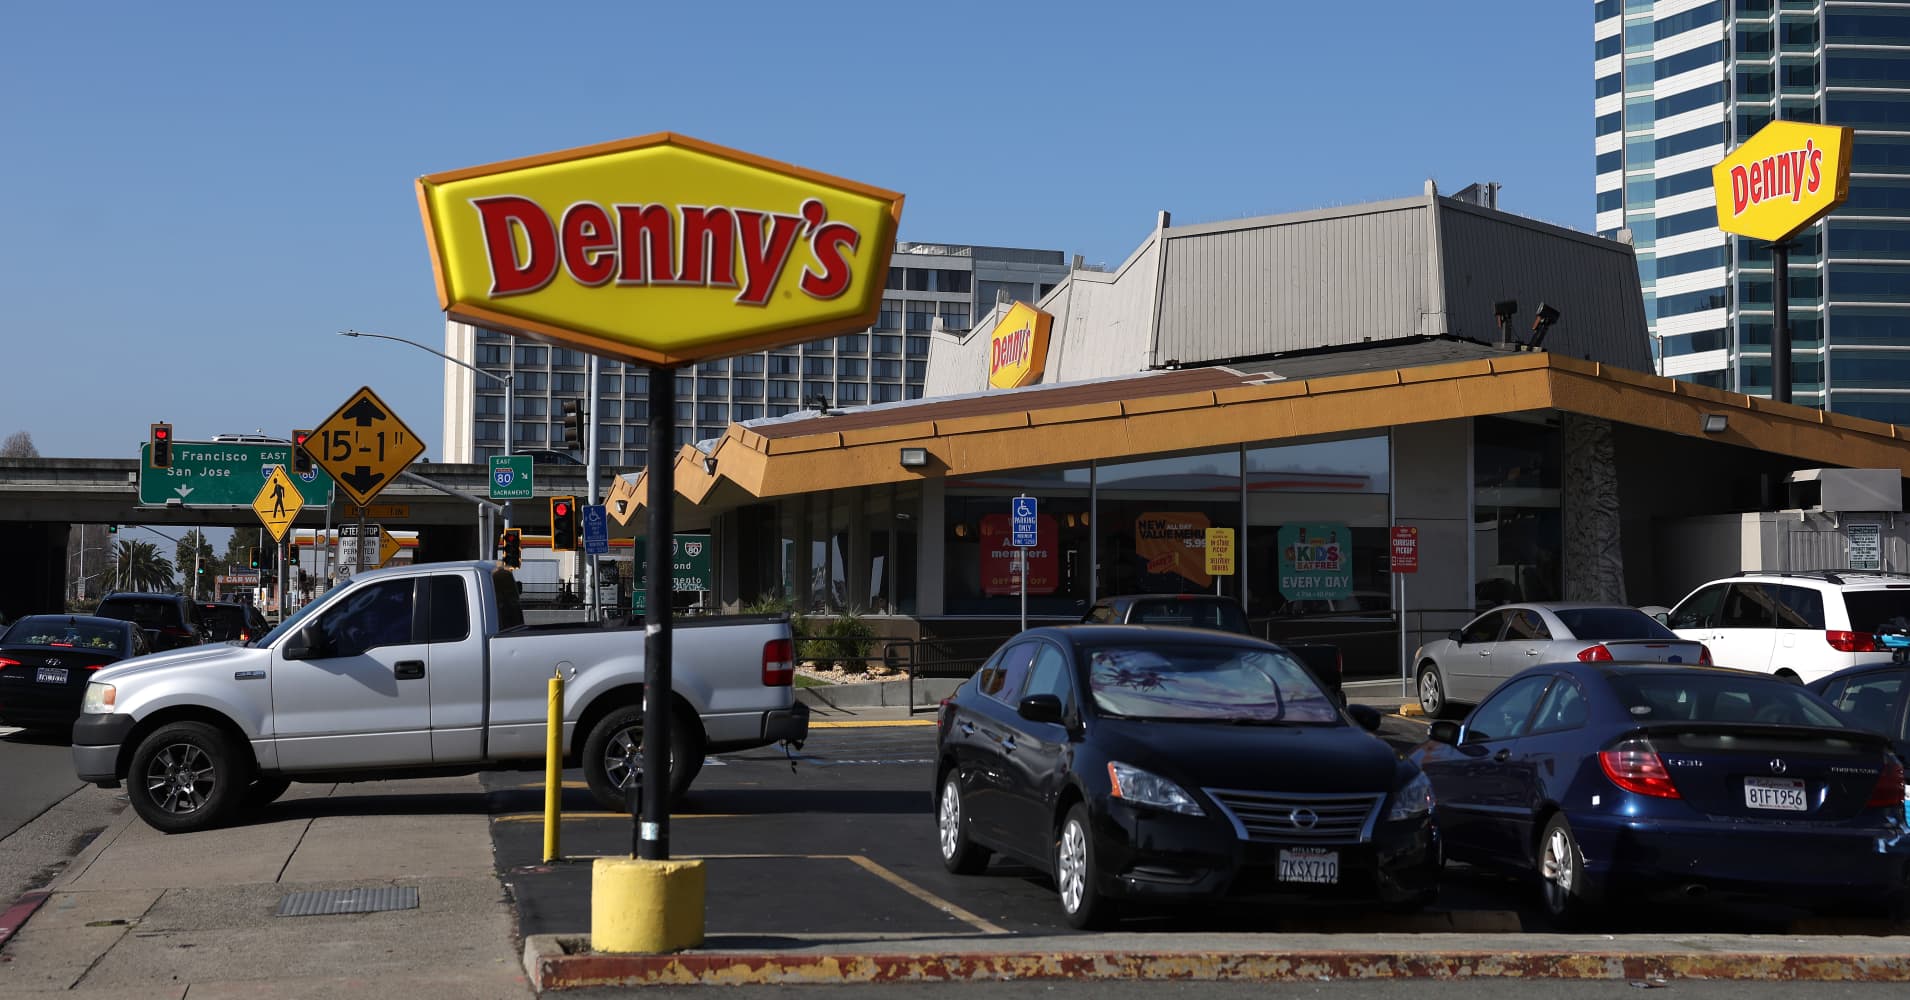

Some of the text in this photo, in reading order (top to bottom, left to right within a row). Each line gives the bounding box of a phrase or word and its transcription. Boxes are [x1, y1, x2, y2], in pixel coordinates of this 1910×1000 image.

[1730, 138, 1822, 217] Denny's
[467, 195, 861, 307] Denny's
[992, 319, 1031, 376] Denny's
[182, 451, 248, 462] Francisco
[260, 452, 287, 460] EAST
[167, 467, 231, 477] San Jose
[497, 473, 511, 483] 80
[1139, 520, 1166, 529] NEW
[1140, 529, 1173, 538] VALUE
[1297, 546, 1339, 561] KIDS
[1282, 576, 1349, 588] EVERY DAY
[1750, 789, 1803, 805] 8TFT956
[1281, 860, 1336, 880] 7KSX710
